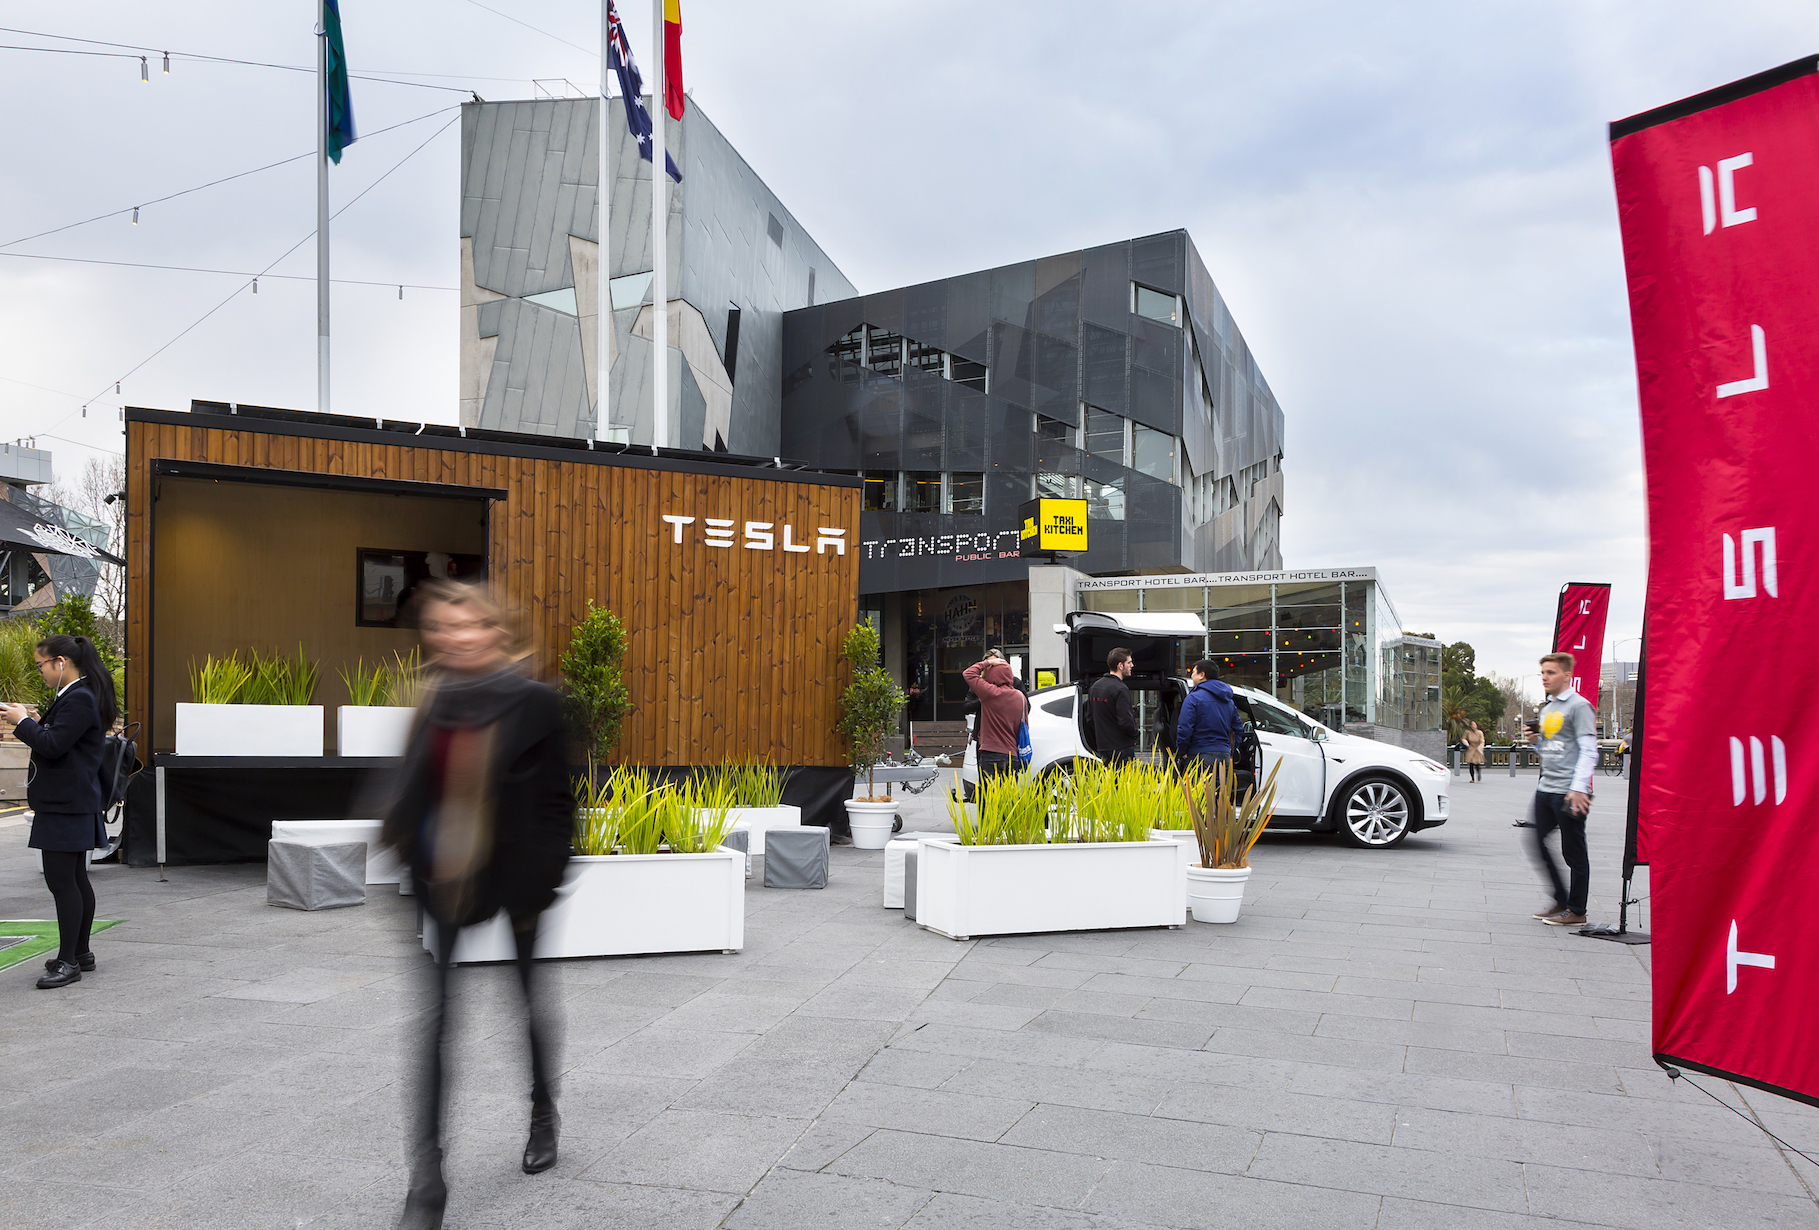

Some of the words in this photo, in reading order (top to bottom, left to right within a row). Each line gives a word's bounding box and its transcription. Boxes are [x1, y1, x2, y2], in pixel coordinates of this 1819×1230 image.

[1053, 516, 1074, 525] TAXI
[662, 515, 846, 556] TESLA
[1044, 525, 1083, 535] KITCHEN
[955, 552, 992, 562] PUBLIC
[999, 550, 1020, 559] BAR
[1078, 579, 1142, 588] TRANSPORT
[1145, 577, 1181, 586] HOTEL
[1290, 572, 1328, 580] HOTEL
[1699, 152, 1787, 995] TESLA
[944, 599, 977, 622] HAHN
